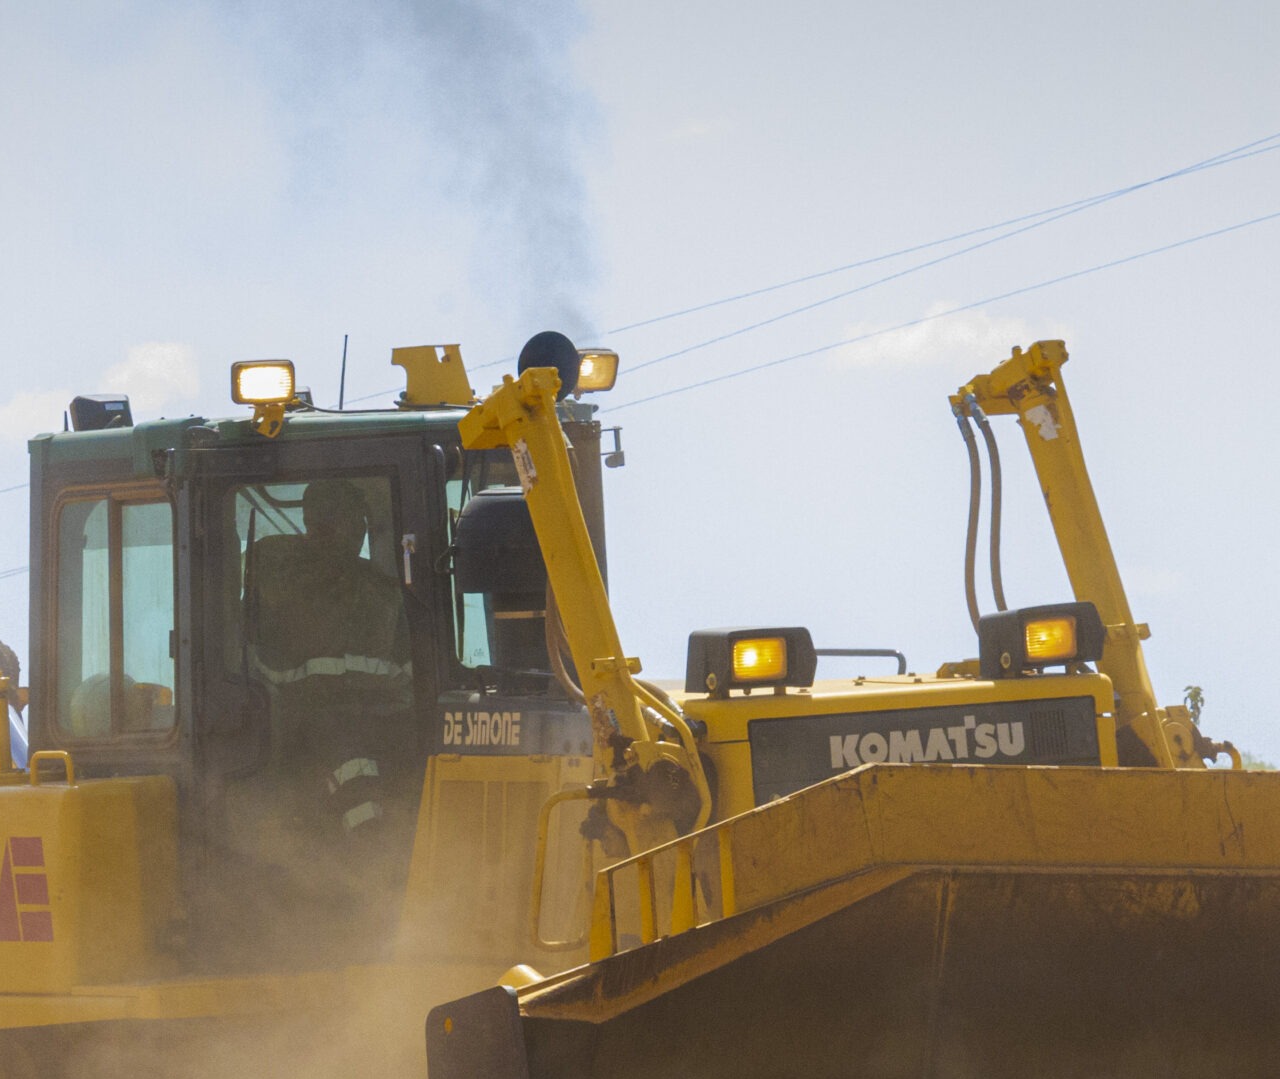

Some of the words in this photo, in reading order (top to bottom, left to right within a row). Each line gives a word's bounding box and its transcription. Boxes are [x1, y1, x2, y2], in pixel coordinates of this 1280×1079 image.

[443, 711, 463, 745] DE
[465, 711, 521, 745] SIMONE
[829, 715, 1025, 768] KOMATSU
